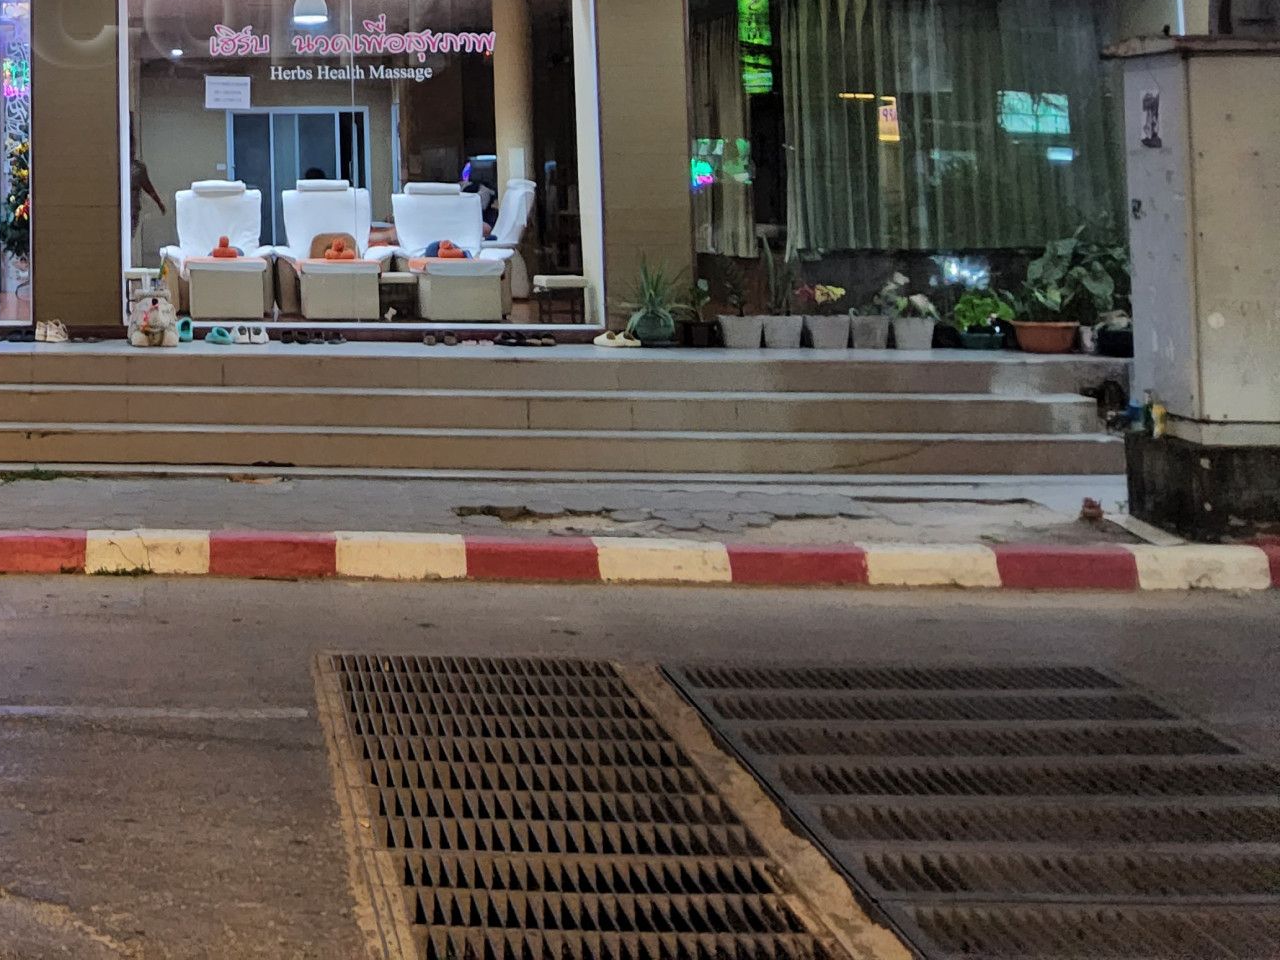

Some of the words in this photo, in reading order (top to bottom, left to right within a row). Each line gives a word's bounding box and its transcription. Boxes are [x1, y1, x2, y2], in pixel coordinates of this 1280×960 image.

[209, 24, 271, 56] เฮิร์บ
[270, 65, 313, 81] Herbs
[317, 65, 365, 80] Health
[369, 64, 434, 82] Massage
